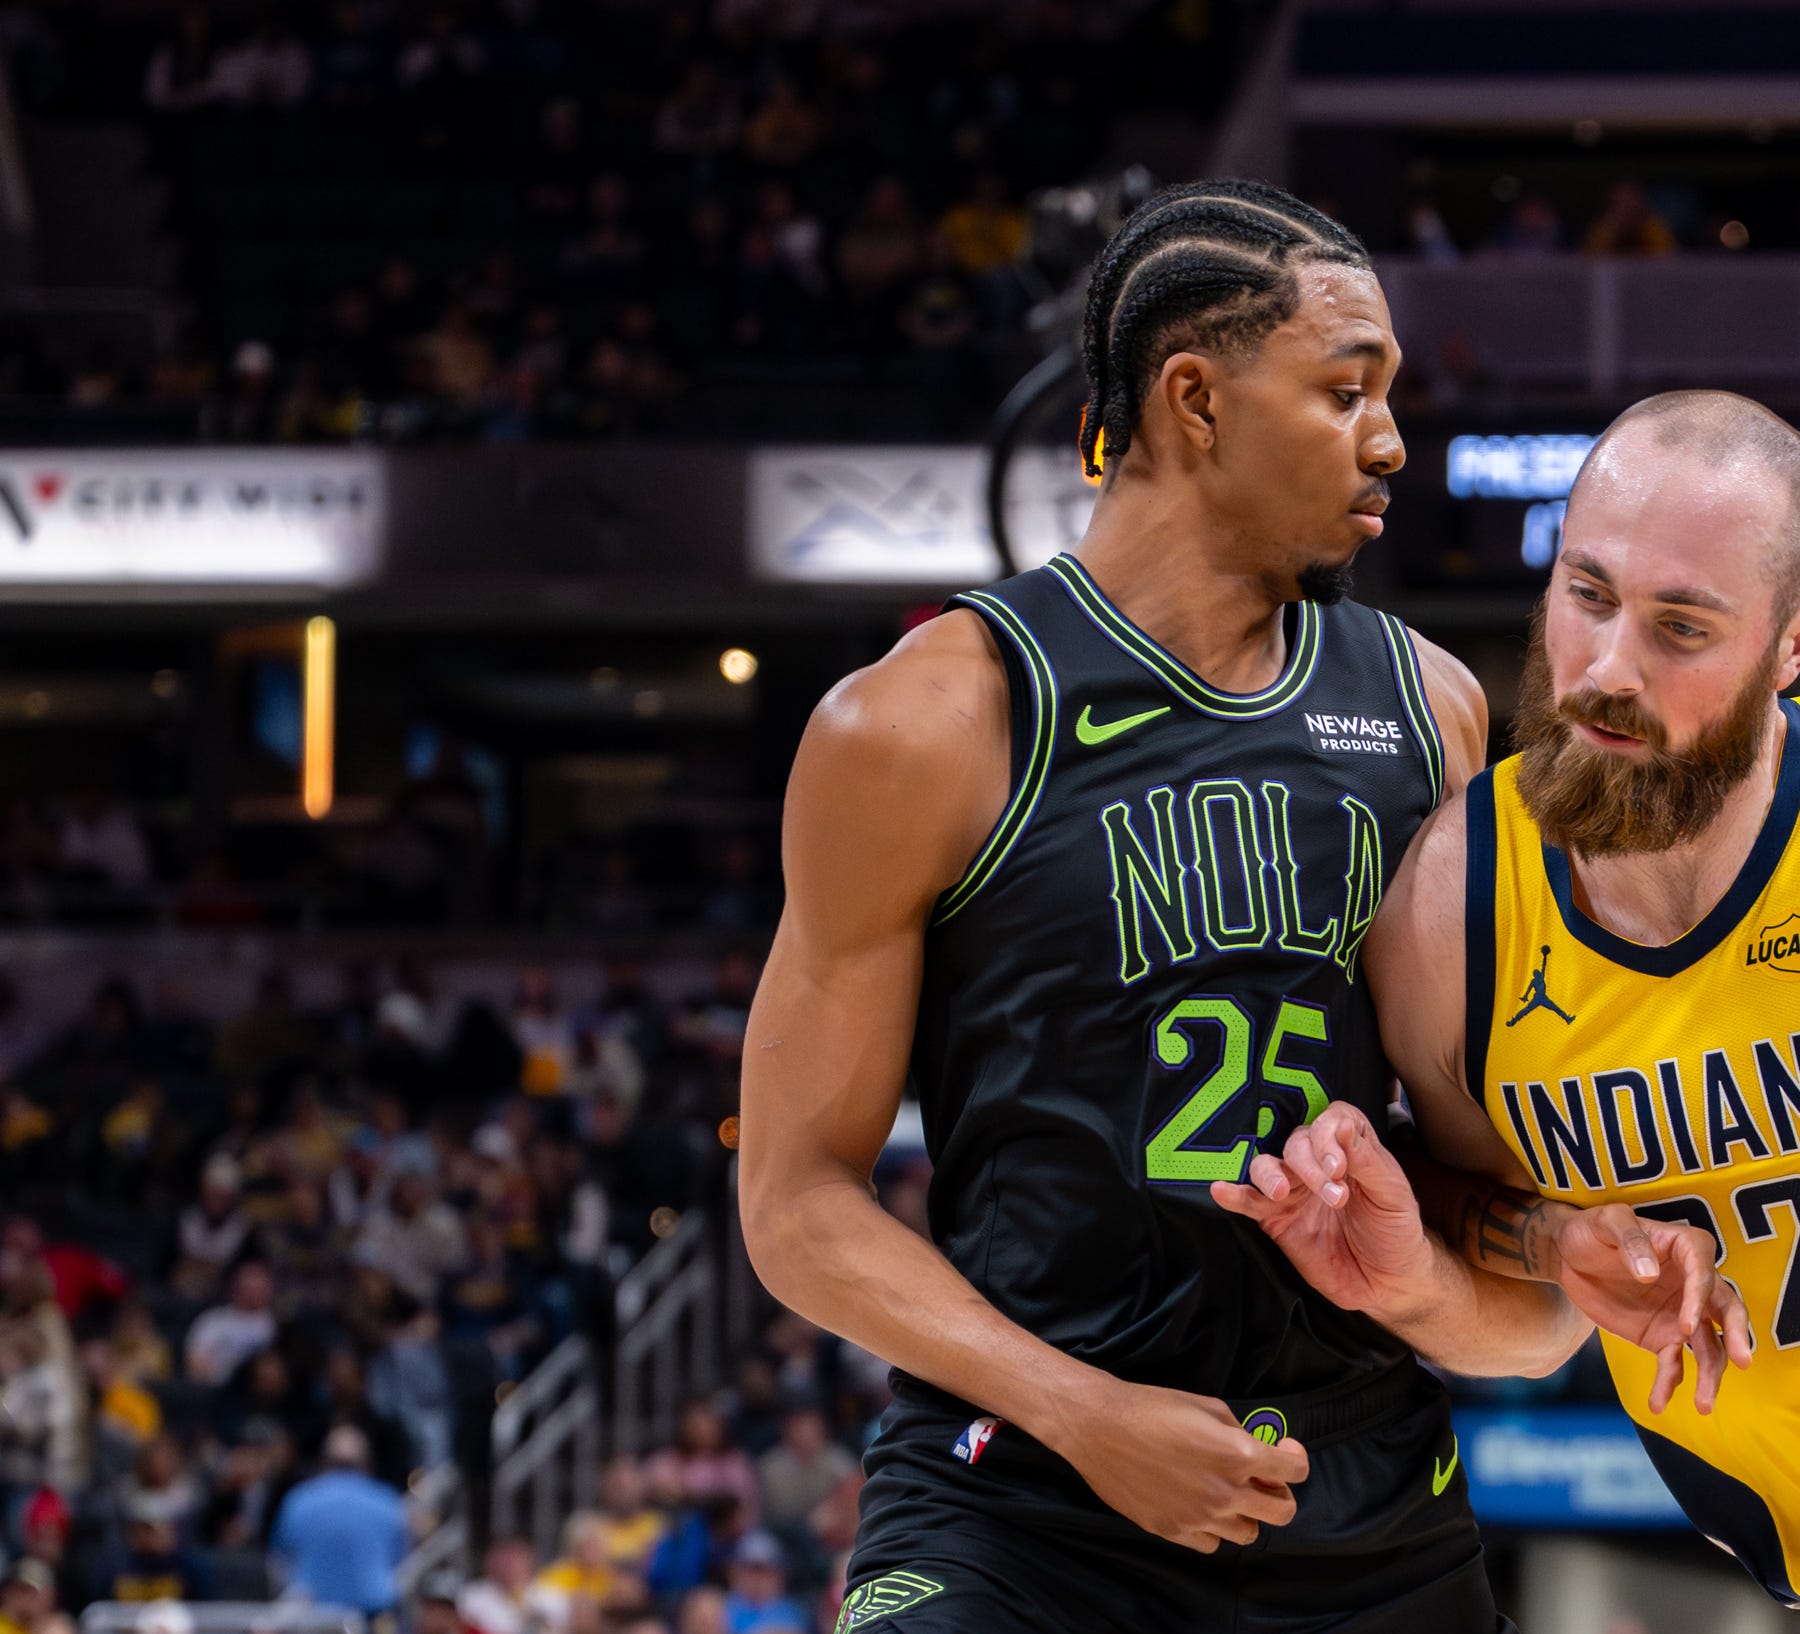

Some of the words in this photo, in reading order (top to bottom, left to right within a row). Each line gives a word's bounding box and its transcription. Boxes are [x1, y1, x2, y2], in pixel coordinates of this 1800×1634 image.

[1304, 713, 1402, 739] NEWAGE
[1320, 738, 1398, 754] PRODUCTS
[1144, 994, 1333, 1186] 25
[953, 1443, 970, 1460] NBA
